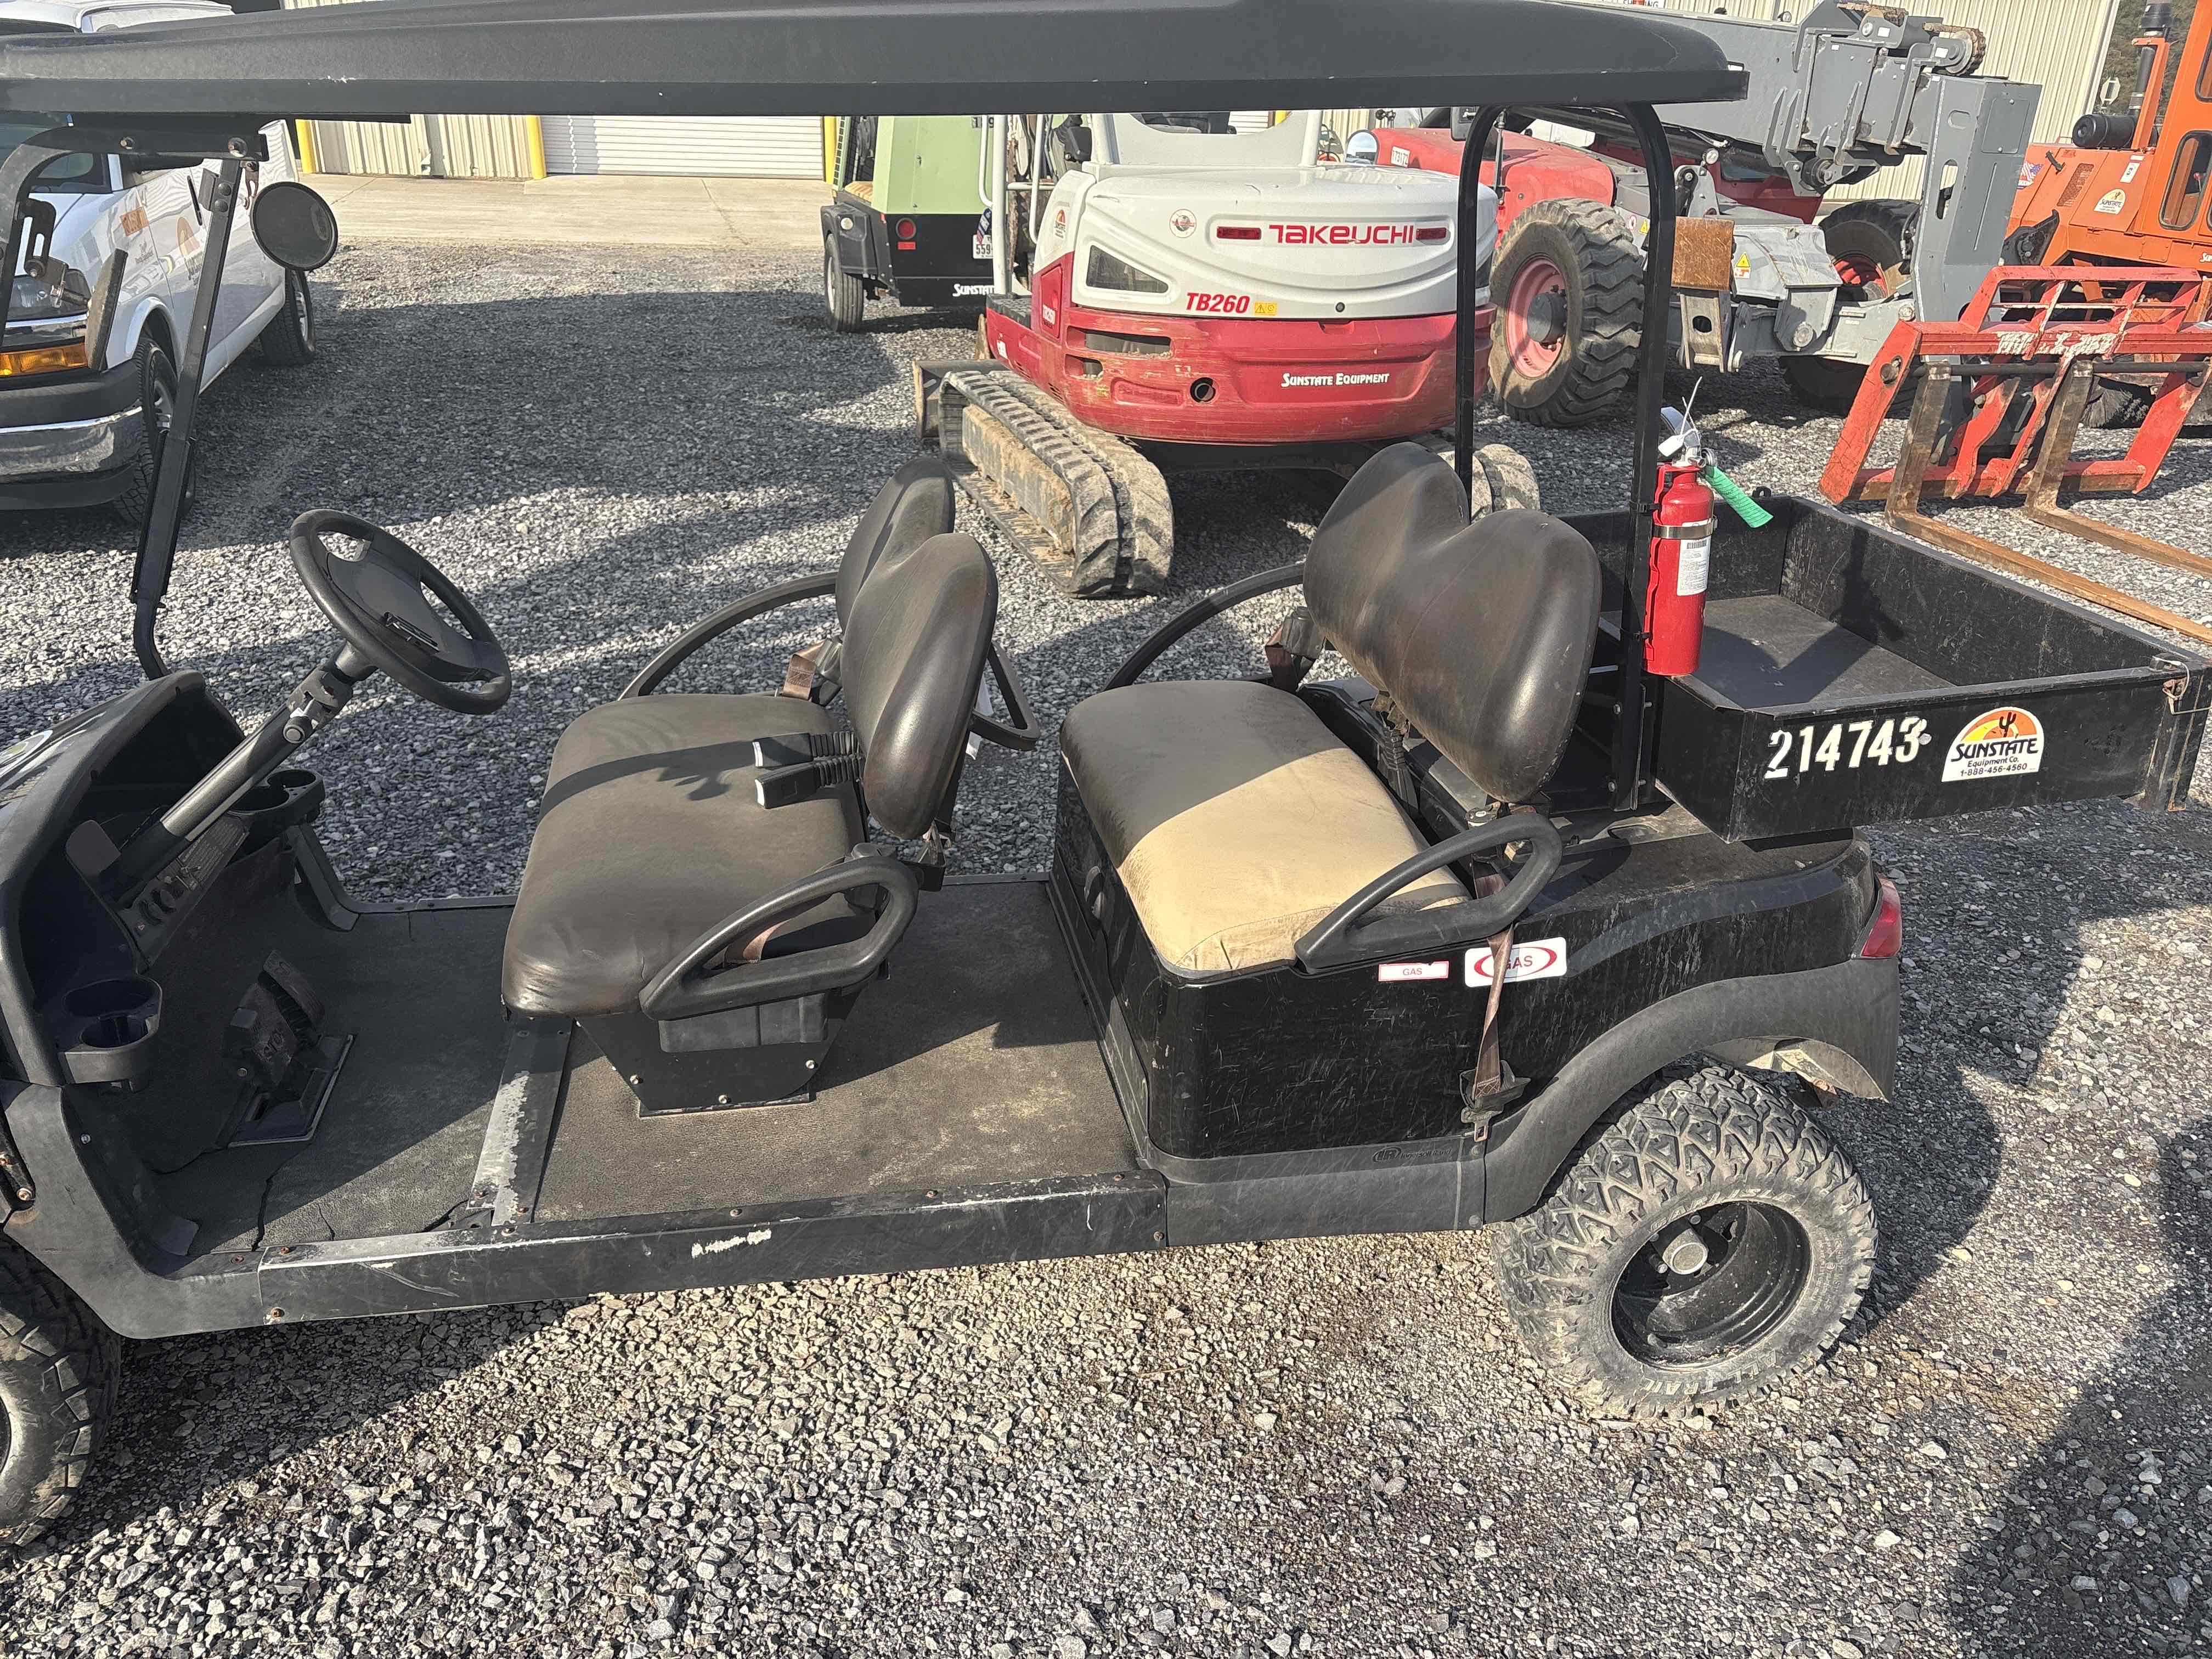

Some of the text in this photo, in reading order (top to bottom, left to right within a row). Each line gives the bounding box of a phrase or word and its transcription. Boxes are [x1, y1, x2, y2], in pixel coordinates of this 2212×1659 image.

[1269, 224, 1414, 244] TAKEUCHI
[975, 244, 994, 255] 559
[952, 284, 996, 297] SUNSTAT
[1186, 292, 1250, 314] TB260
[1281, 373, 1390, 387] SUNSTATE EQUIPMENT
[1764, 715, 1927, 779] 214743
[1951, 738, 2039, 762] SUNSTATE
[1960, 763, 2028, 777] 1-888-456-4560
[1967, 759, 2007, 768] Equipment
[1402, 968, 1423, 976] GAS
